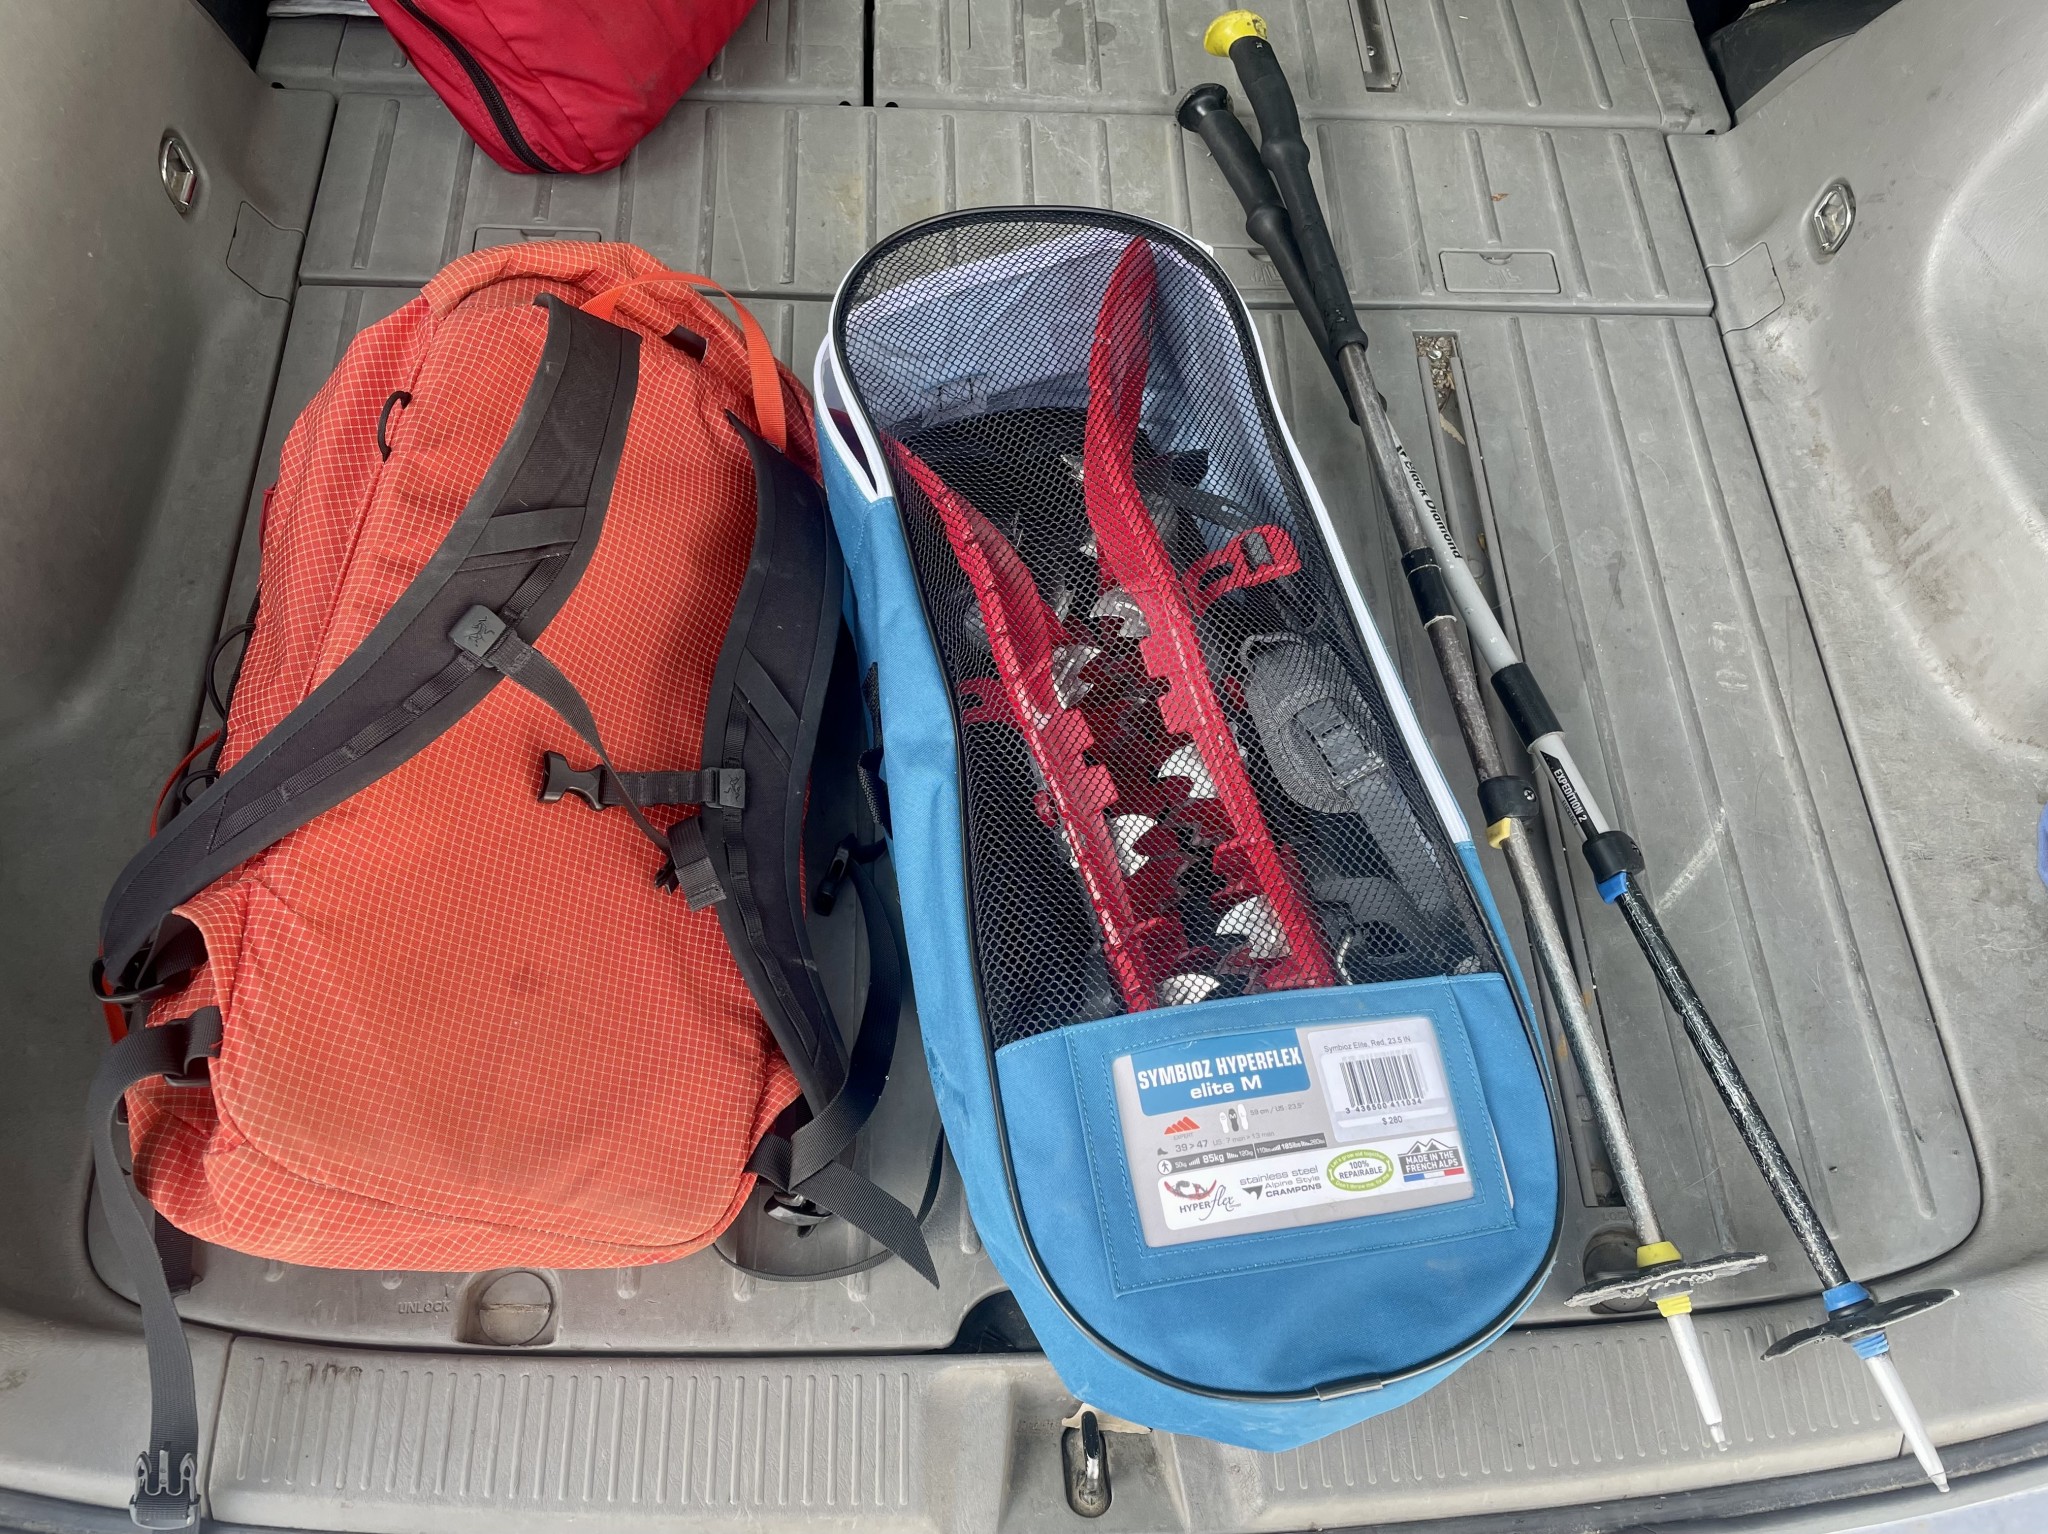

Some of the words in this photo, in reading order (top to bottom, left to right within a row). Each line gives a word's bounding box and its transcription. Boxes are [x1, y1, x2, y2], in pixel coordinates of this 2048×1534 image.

[1425, 499, 1463, 559] Diamond
[1553, 768, 1584, 815] EXPEDITION
[1578, 814, 1588, 823] 2
[1324, 1044, 1352, 1054] Symbioz
[1387, 1037, 1403, 1045] 23.5
[1137, 1059, 1213, 1090] SYMBIOZ
[1215, 1047, 1302, 1076] HYPERFLEX
[1190, 1081, 1235, 1099] elite
[1240, 1075, 1262, 1091] M
[1389, 1115, 1403, 1125] 280
[1175, 1143, 1188, 1153] 39
[1196, 1139, 1208, 1149] 47
[1202, 1152, 1225, 1164] 85kg
[1349, 1160, 1370, 1169] 100%
[1405, 1153, 1429, 1165] MADE
[1430, 1152, 1438, 1161] IN
[1438, 1150, 1455, 1160] THE
[1338, 1166, 1383, 1179] REPAIRABLE
[1405, 1160, 1438, 1173] FRENCH
[1439, 1158, 1459, 1168] ALPS
[1240, 1170, 1289, 1186] stainless
[1291, 1165, 1319, 1177] steel
[1264, 1179, 1293, 1190] Alpine
[1295, 1175, 1320, 1185] Style
[1265, 1182, 1322, 1198] CRAMPONS
[398, 1301, 451, 1314] UNLOCK
